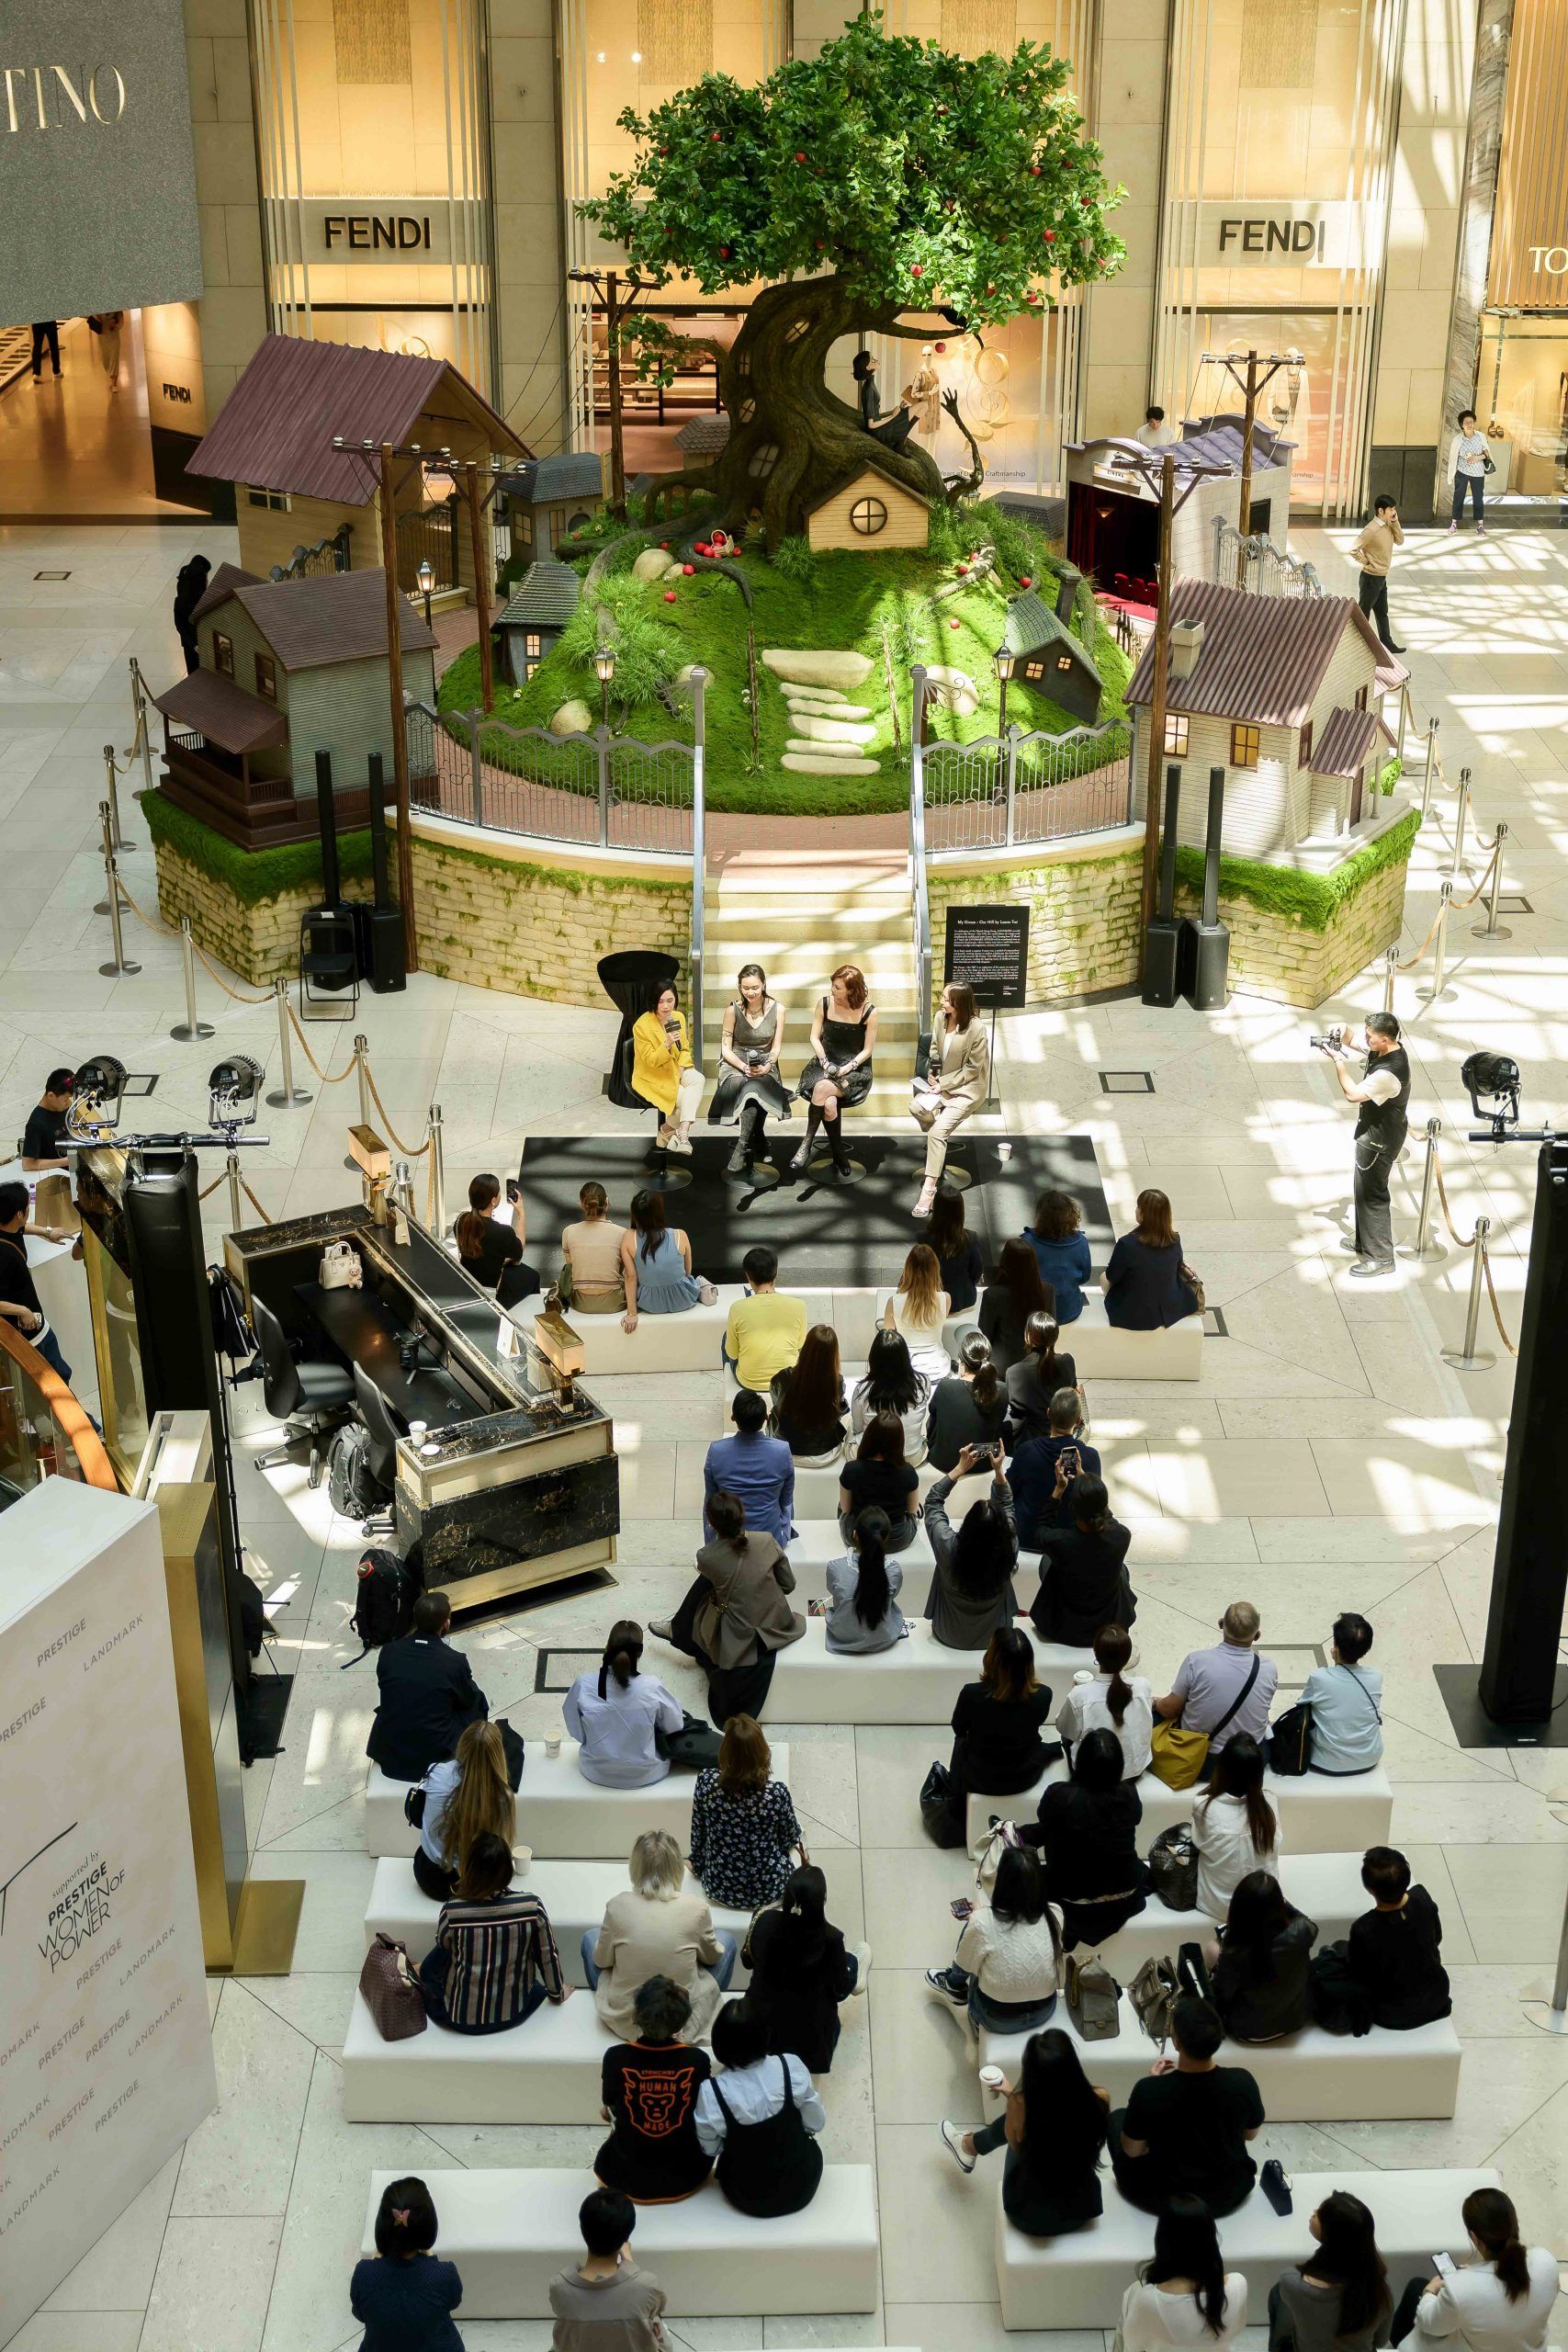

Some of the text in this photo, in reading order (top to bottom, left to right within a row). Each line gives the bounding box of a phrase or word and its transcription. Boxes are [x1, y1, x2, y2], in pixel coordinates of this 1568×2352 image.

[0, 62, 126, 133] TINO
[324, 216, 431, 249] FENDI
[1219, 220, 1325, 256] FENDI
[1529, 246, 1568, 275] TO
[163, 383, 191, 404] FENDI
[37, 1618, 87, 1668] PRESTIGE
[83, 1612, 144, 1671] LANDMARK
[48, 1861, 107, 1927] PRESTIGE
[51, 1850, 100, 1899] supported by
[50, 1902, 111, 1973] POWER
[76, 1938, 123, 1990] PRESTIGE
[118, 1924, 175, 1986] LANDMARK
[38, 2015, 86, 2070] PRESTIGE
[85, 2008, 132, 2063] PRESTIGE
[128, 1993, 184, 2058] LANDMARK
[95, 2079, 141, 2132] PRESTIGE
[639, 2081, 676, 2092] HUMAN
[48, 2086, 96, 2142] PRESTIGE
[643, 2120, 671, 2132] MADE
